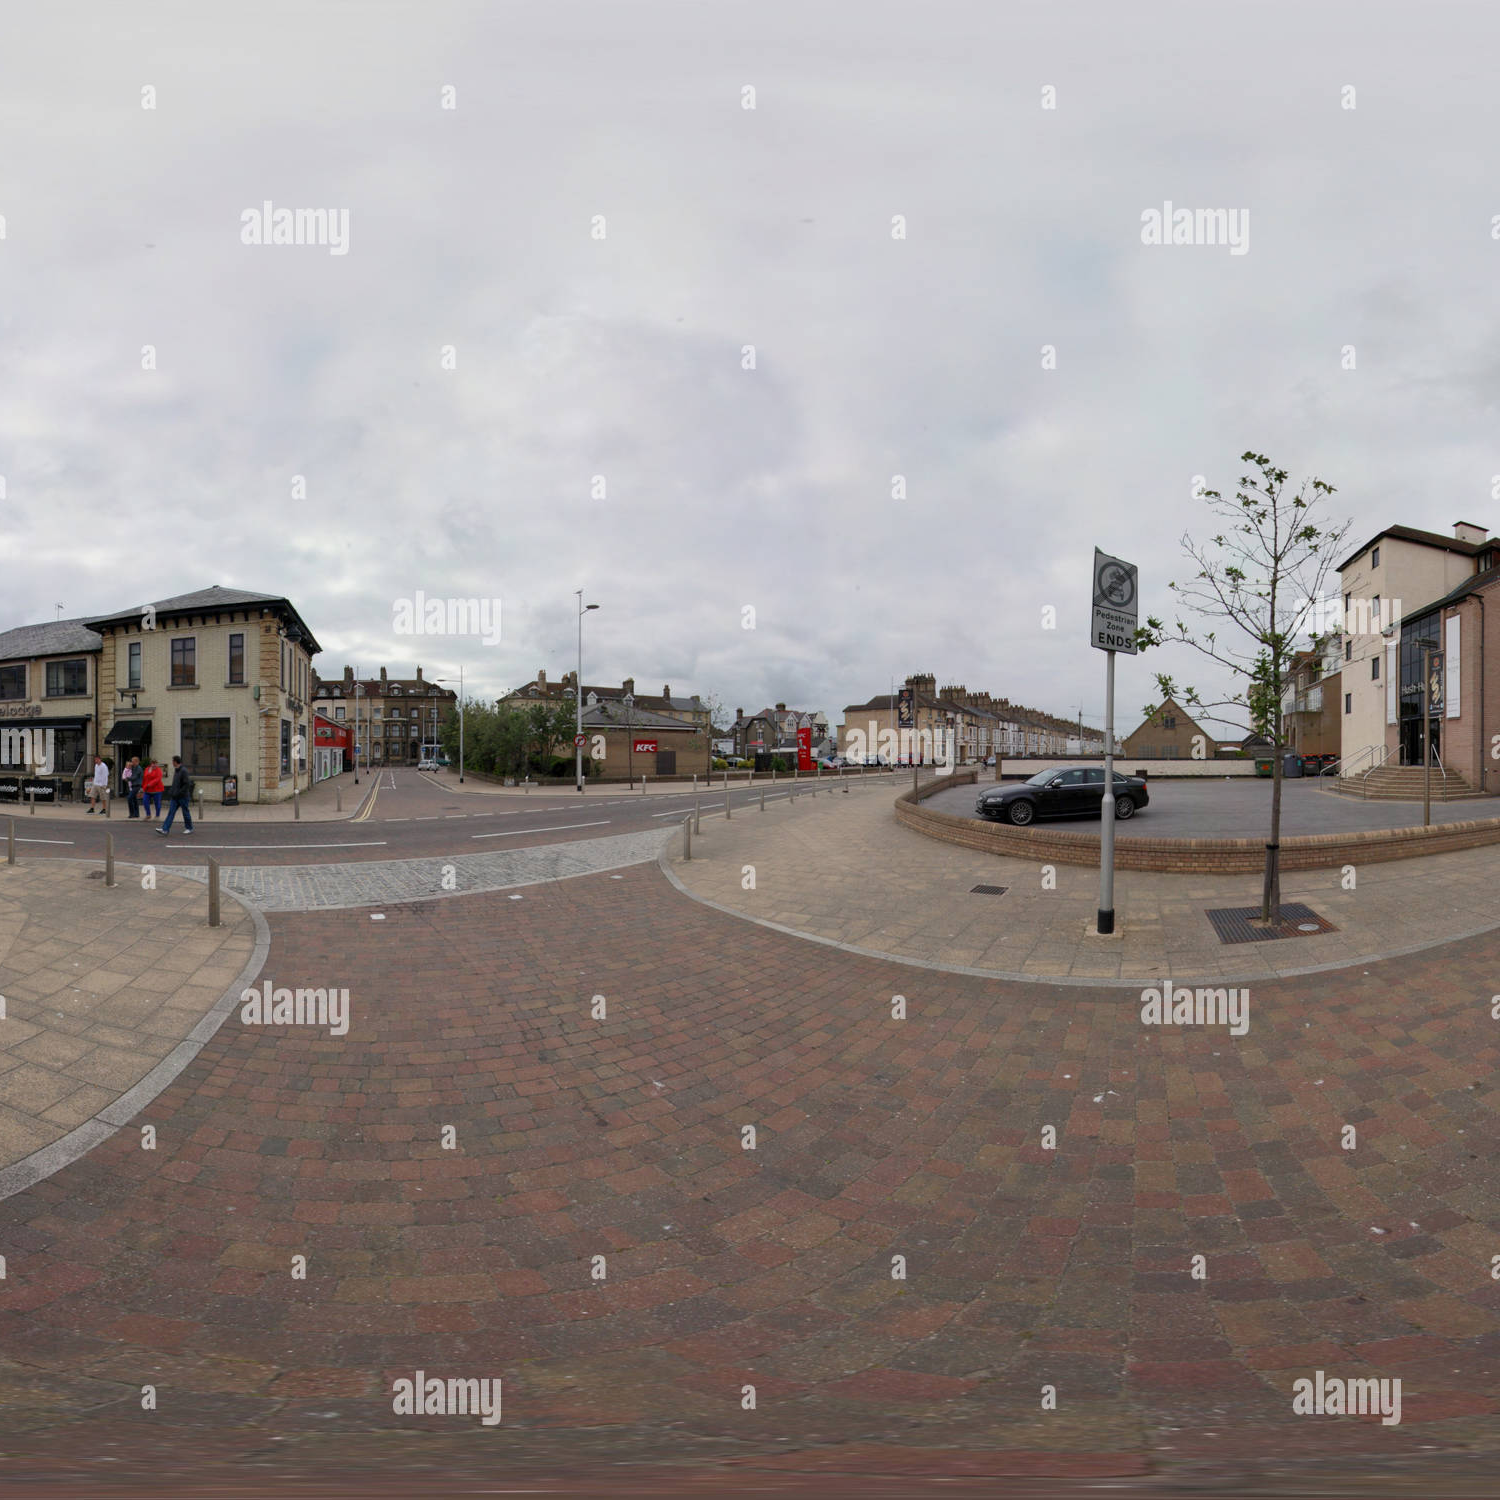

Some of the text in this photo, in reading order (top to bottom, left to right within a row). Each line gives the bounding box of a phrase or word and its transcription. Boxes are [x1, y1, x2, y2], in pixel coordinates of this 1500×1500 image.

[1096, 610, 1135, 626] Pedestrian
[1106, 621, 1125, 632] Zone
[1098, 632, 1132, 648] ENDS
[636, 743, 657, 752] KFC
